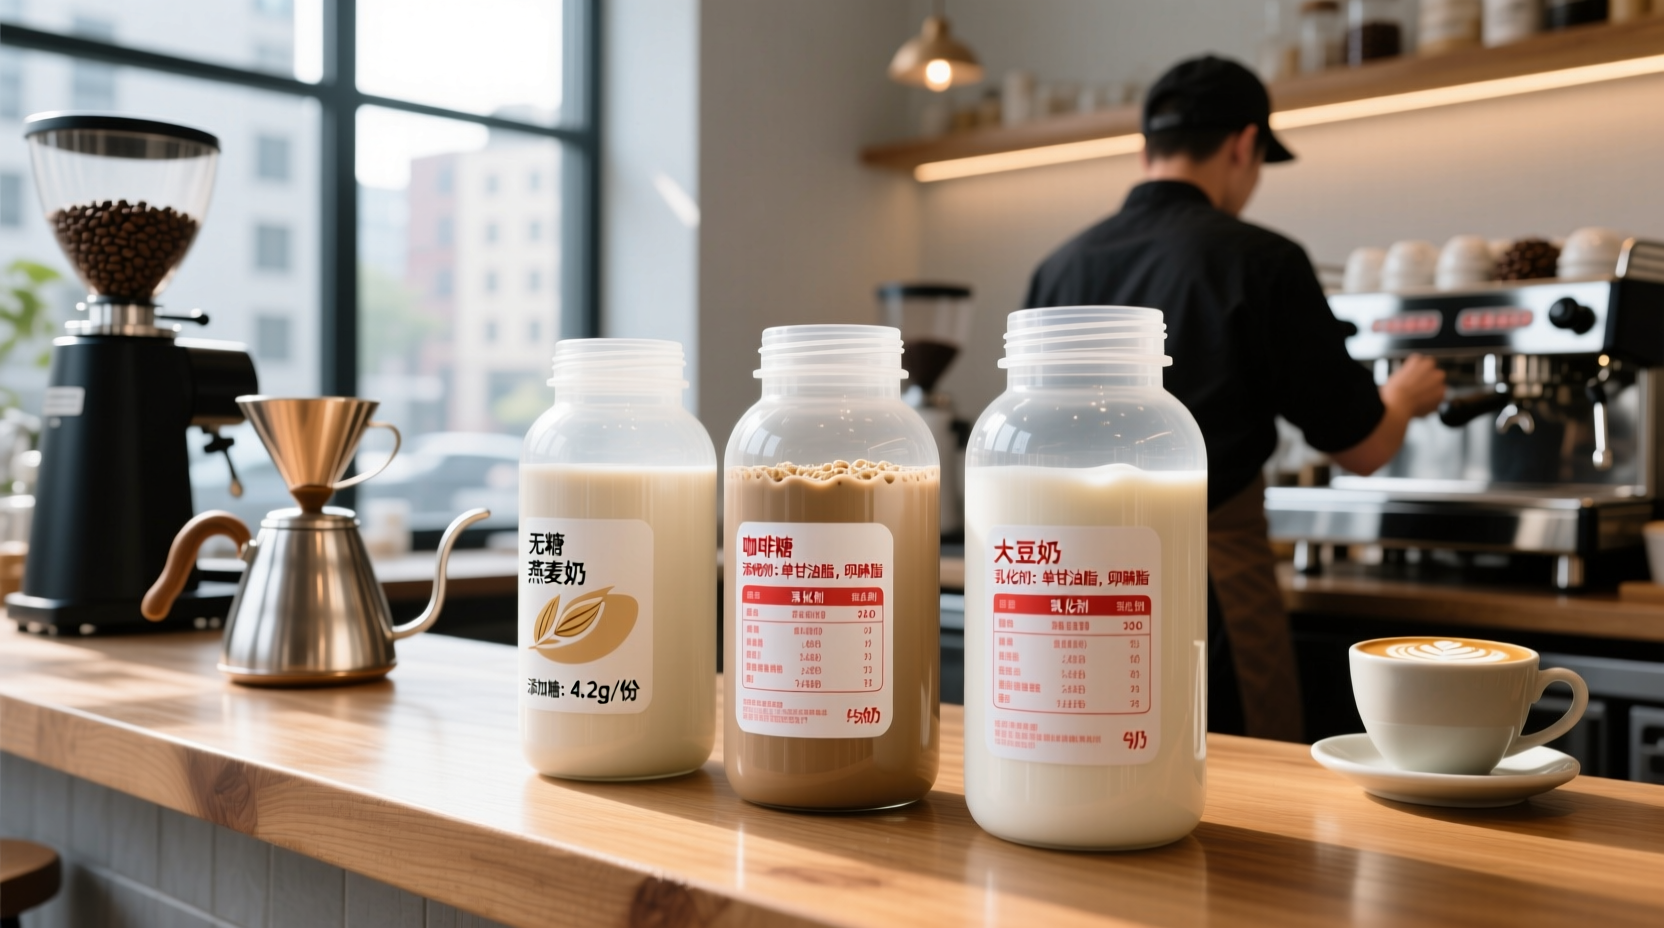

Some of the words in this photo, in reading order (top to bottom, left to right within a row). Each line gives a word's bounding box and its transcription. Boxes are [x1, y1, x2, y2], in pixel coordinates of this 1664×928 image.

[528, 532, 565, 556] 无糖
[994, 538, 1061, 565] 大豆奶
[527, 560, 586, 585] 燕麦奶
